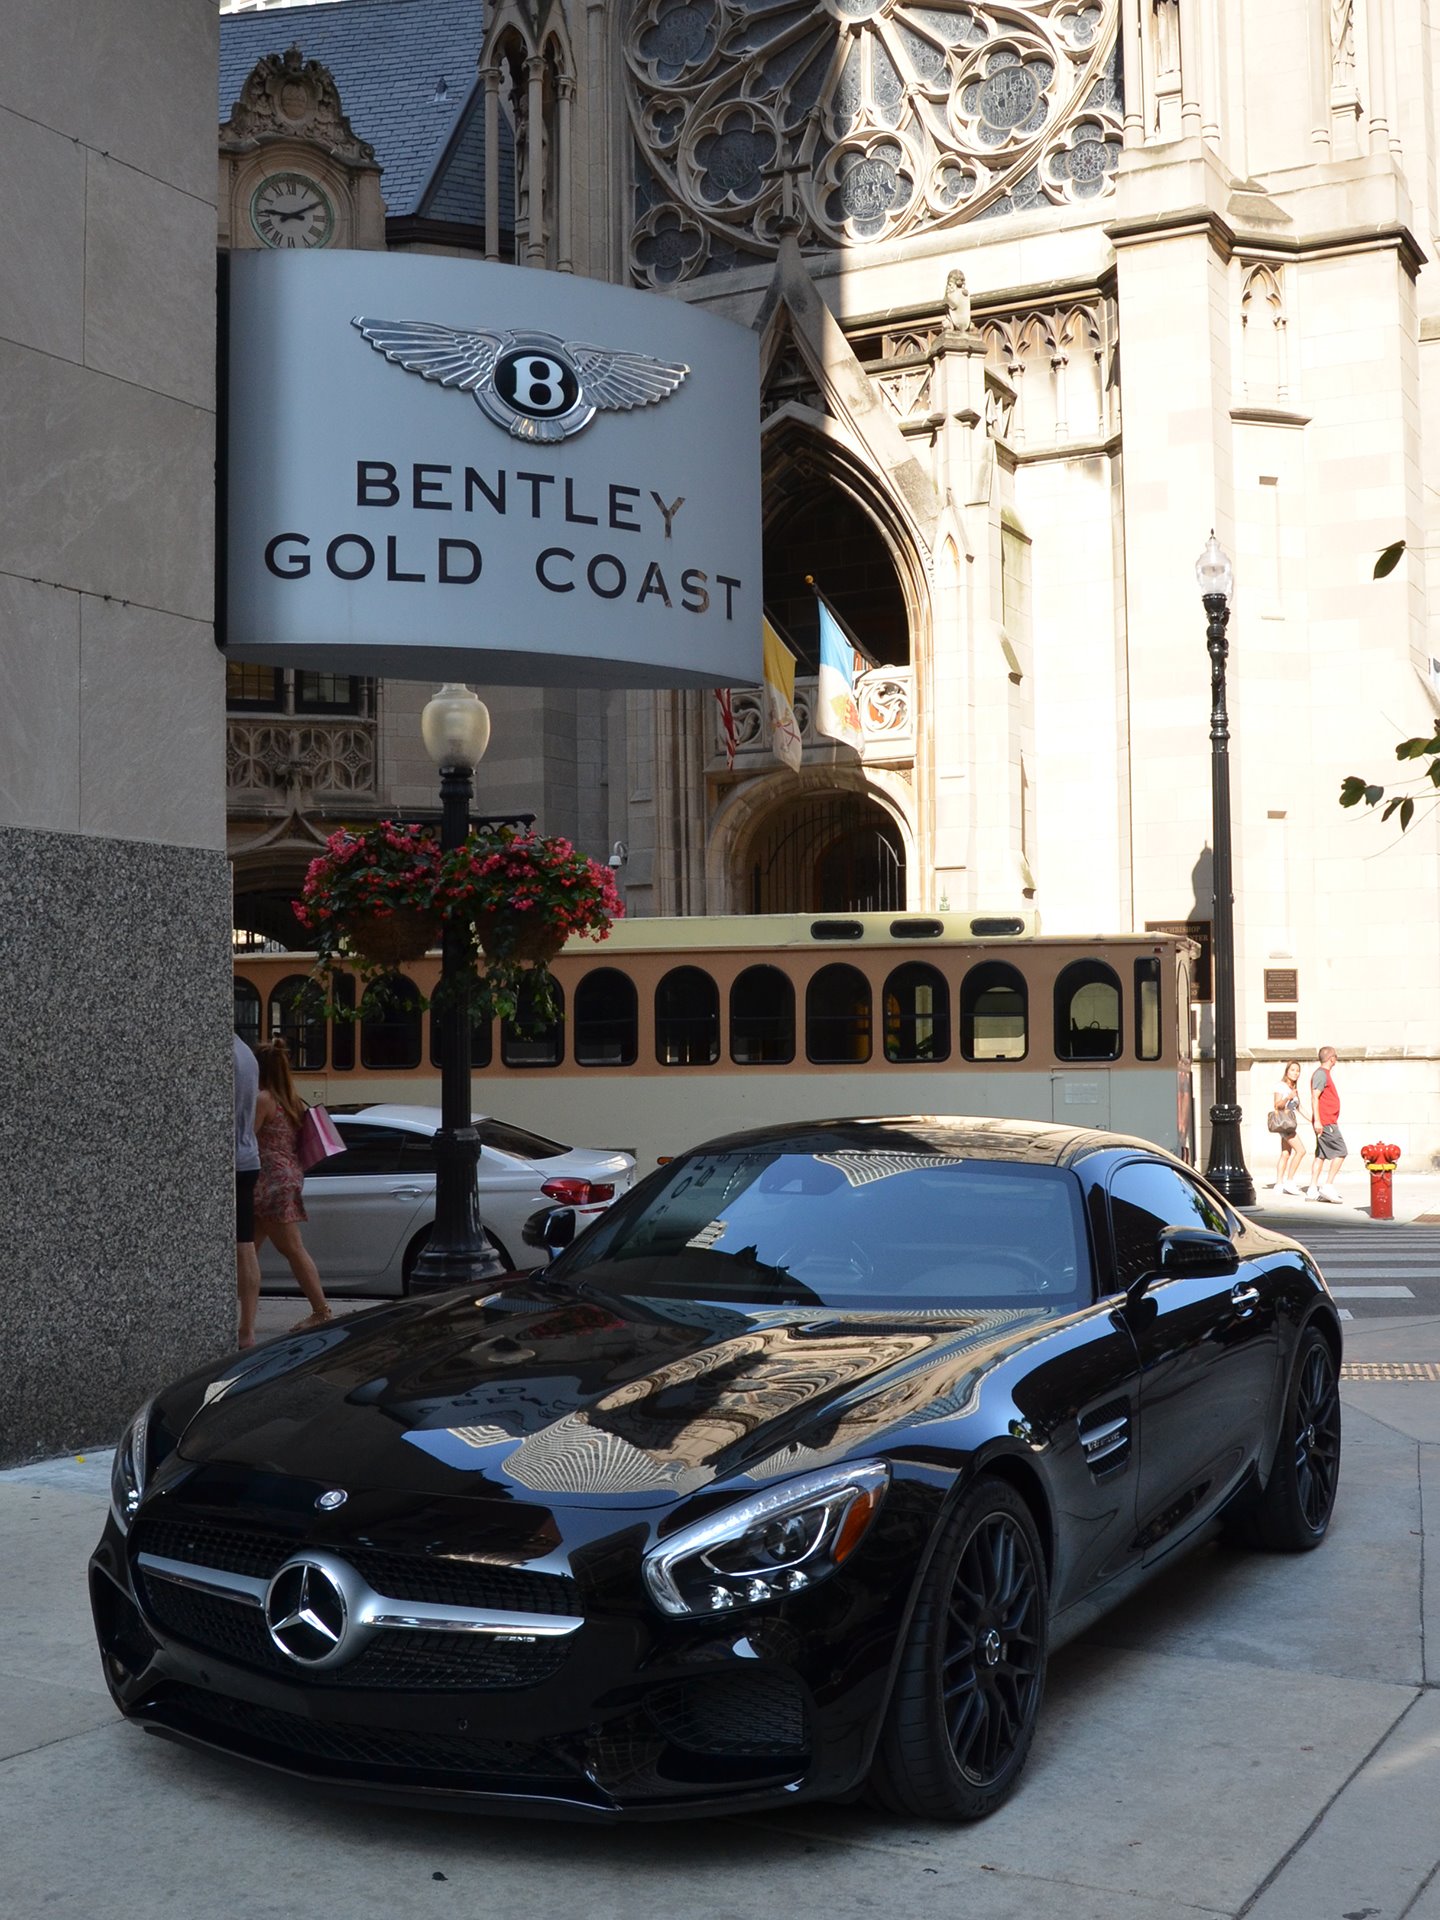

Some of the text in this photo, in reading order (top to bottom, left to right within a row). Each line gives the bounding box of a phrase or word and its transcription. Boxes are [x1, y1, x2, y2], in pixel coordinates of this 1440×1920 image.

[512, 355, 565, 411] B
[356, 460, 686, 539] BENTLEY
[264, 532, 742, 622] GOLD COAST
